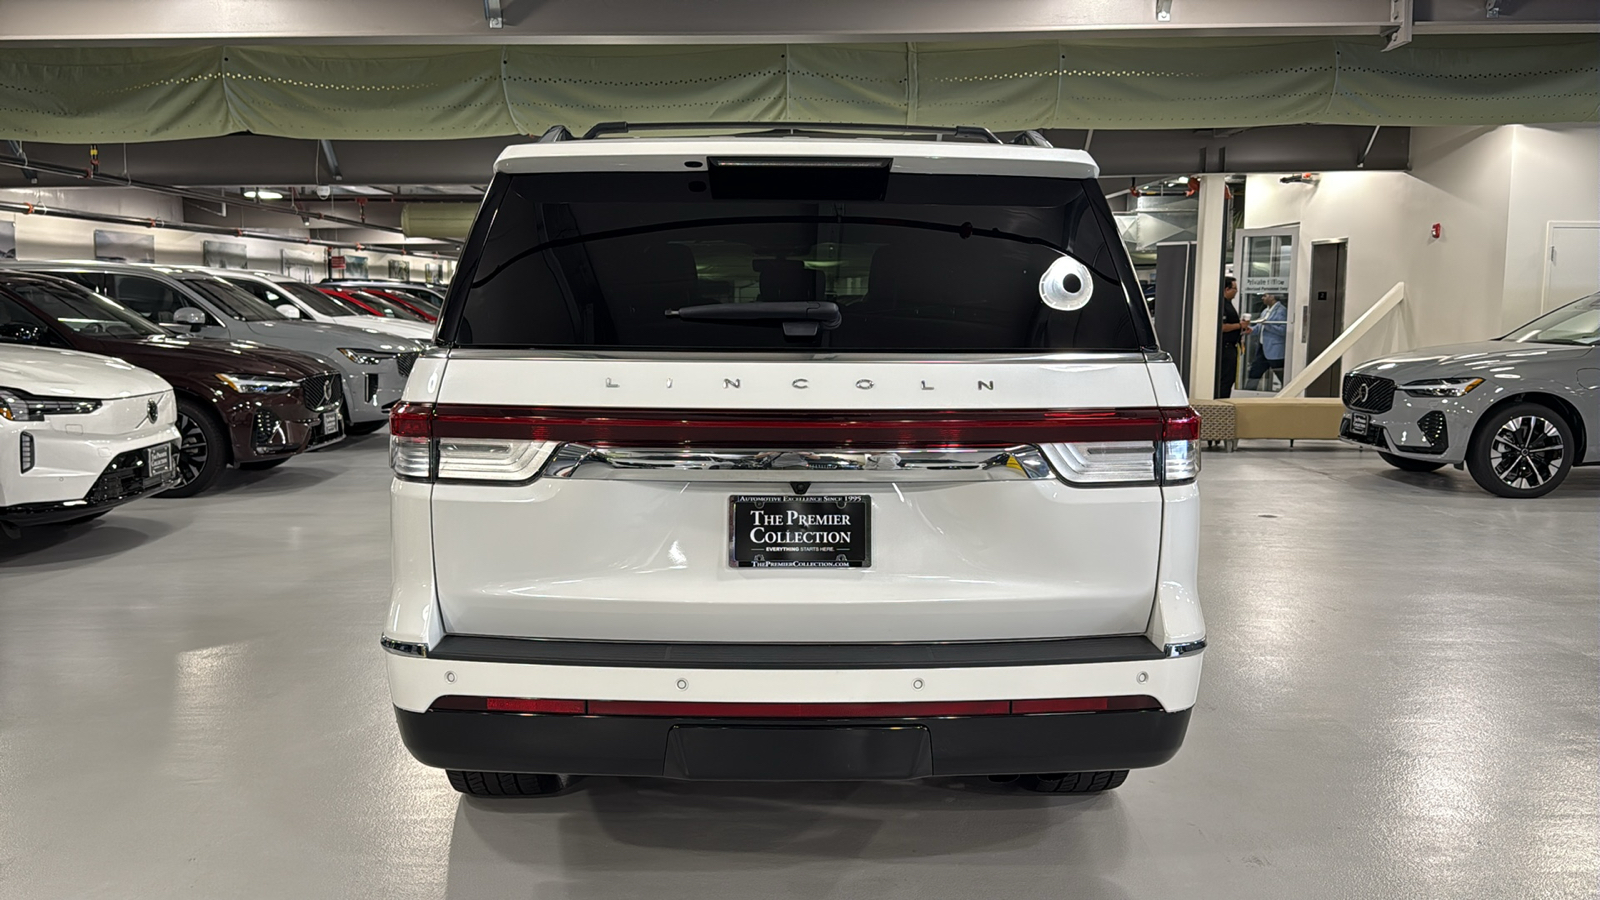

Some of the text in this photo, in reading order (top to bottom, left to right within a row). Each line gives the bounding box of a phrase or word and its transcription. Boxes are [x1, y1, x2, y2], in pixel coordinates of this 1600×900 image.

[605, 377, 994, 391] LINCOLN
[750, 510, 851, 526] THE PREMIER
[750, 527, 851, 543] COLLECTION
